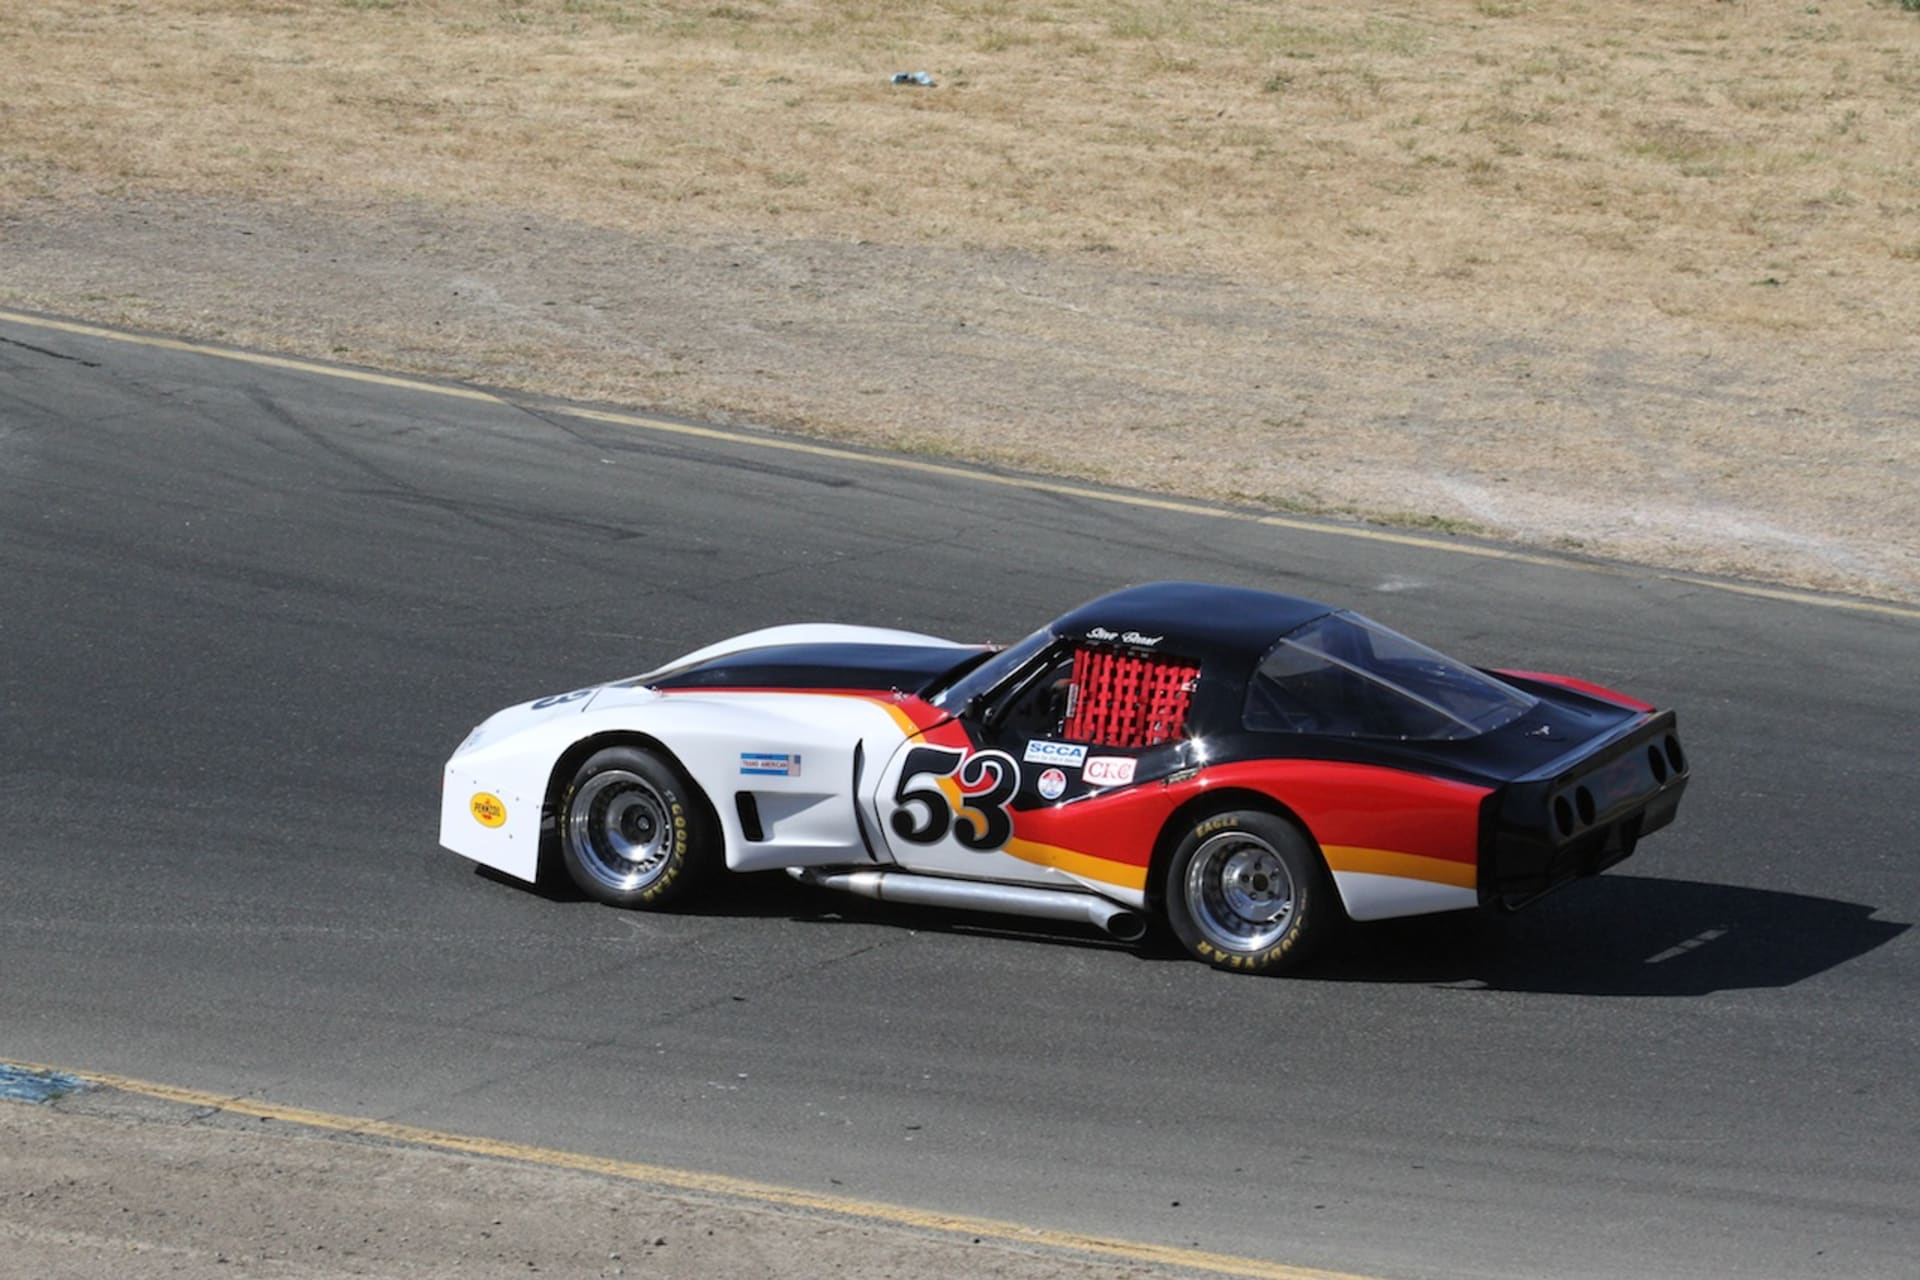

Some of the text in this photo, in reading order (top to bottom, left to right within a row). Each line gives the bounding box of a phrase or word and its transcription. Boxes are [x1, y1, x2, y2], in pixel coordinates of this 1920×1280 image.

[1029, 742, 1082, 757] SCCA
[892, 745, 1019, 852] 53
[1196, 817, 1239, 838] EAGLE
